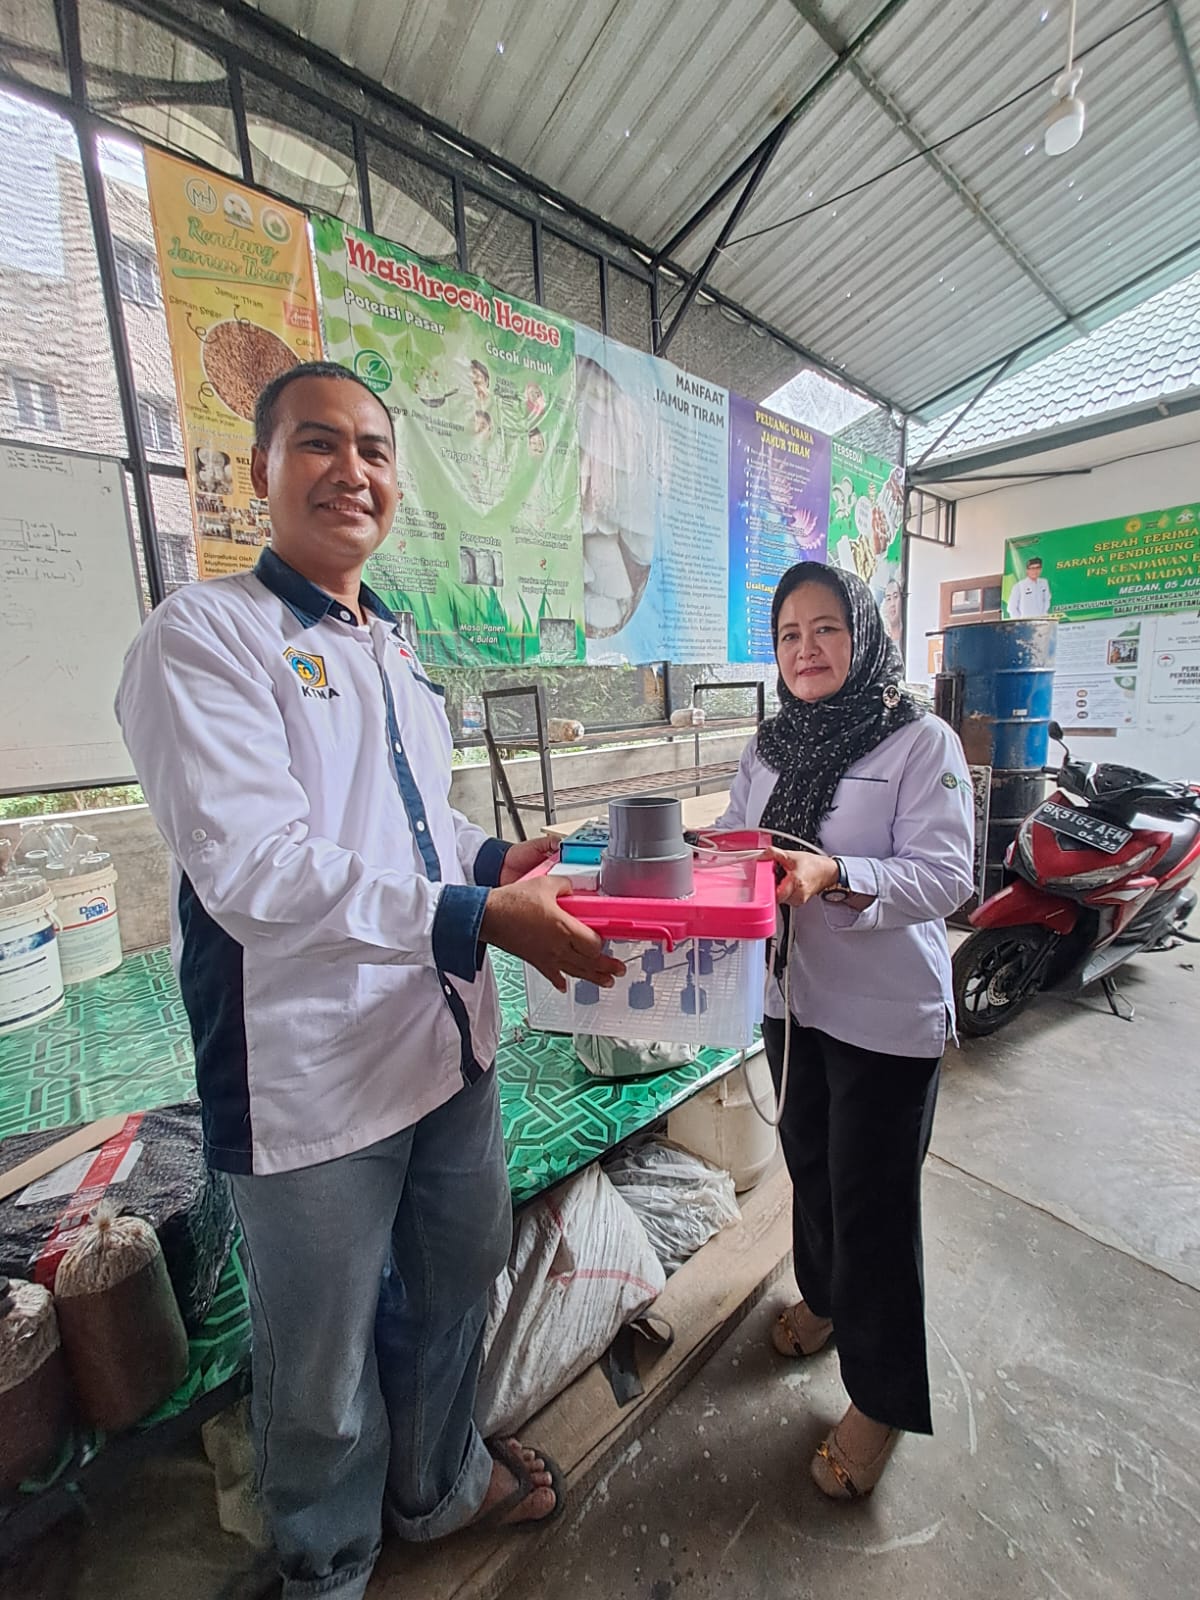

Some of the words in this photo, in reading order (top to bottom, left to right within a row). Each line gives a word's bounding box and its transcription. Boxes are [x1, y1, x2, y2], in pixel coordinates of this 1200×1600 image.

[187, 215, 279, 267] Rendang
[344, 236, 492, 323] Mashroom
[494, 296, 561, 348] House
[343, 287, 402, 321] Potensi
[405, 310, 446, 336] Pasar
[485, 341, 520, 367] Cocok
[522, 356, 555, 377] untuk
[676, 373, 725, 407] MANFAAT
[653, 388, 690, 416] JAMUR
[692, 404, 725, 429] TIRAM
[755, 410, 789, 435] PELUANG
[790, 422, 815, 446] USAHA
[761, 431, 787, 451] JAMUR
[787, 440, 811, 460] TIRAM
[1094, 536, 1138, 552] SERAH
[1144, 527, 1199, 545] TERIMA
[1056, 555, 1105, 569] SARANA
[1109, 540, 1194, 562] PENDUKUNG
[1111, 553, 1188, 574] CENDAWAN
[1107, 573, 1141, 586] KOTA
[1144, 565, 1194, 581] MADYA
[1119, 583, 1161, 595] MEDAN,
[1164, 580, 1178, 591] 05
[1133, 602, 1168, 612] PELATIHAN
[460, 624, 481, 633] Masa
[483, 624, 506, 633] Panen
[476, 635, 498, 644] Bulan
[301, 685, 341, 700] KTNA
[1094, 824, 1129, 843] AFM
